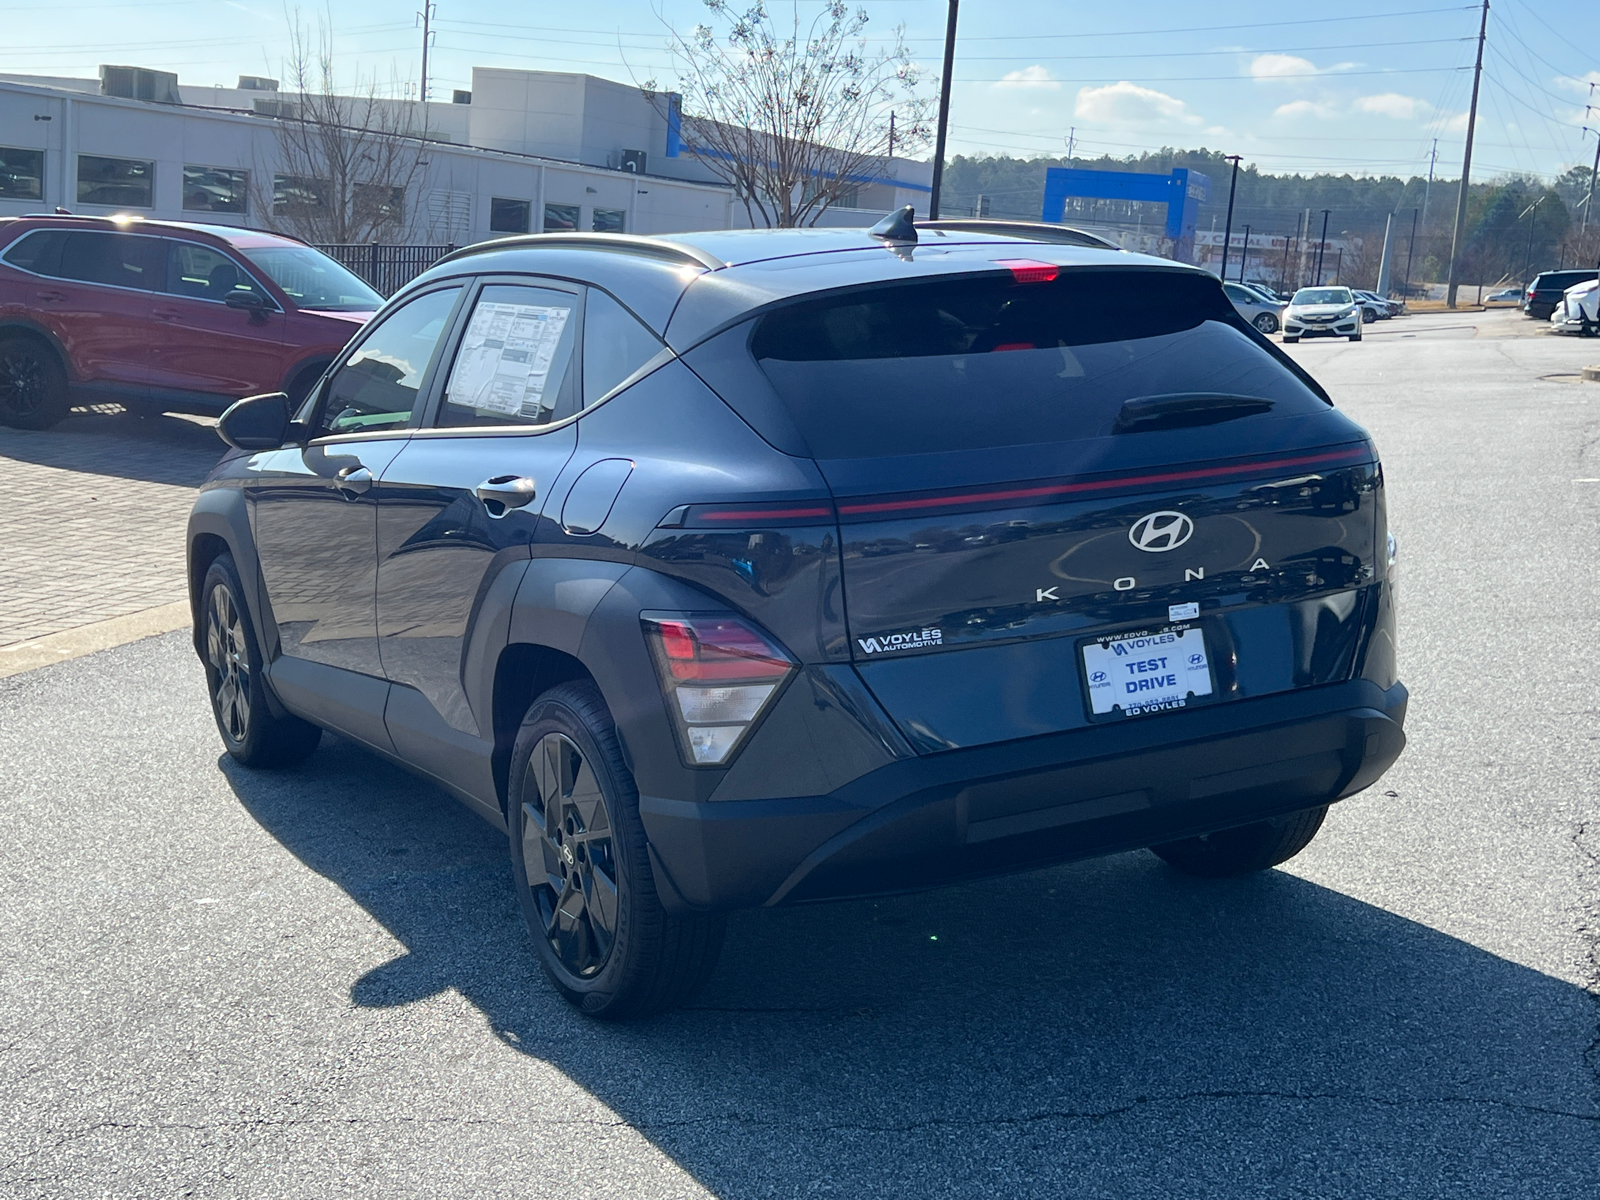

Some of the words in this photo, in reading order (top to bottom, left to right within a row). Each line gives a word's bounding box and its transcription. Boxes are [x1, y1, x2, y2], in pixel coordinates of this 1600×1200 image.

[1036, 558, 1270, 602] KONA
[880, 629, 942, 645] VOYLES
[1096, 623, 1190, 643] WWW.EDVOS.COM
[1127, 634, 1175, 650] VOYLES
[883, 638, 943, 652] AUTOMOTIVE
[1126, 657, 1168, 675] TEST
[1125, 674, 1177, 694] DRIVE
[1125, 707, 1141, 717] ED
[1142, 699, 1186, 714] VOYLES
